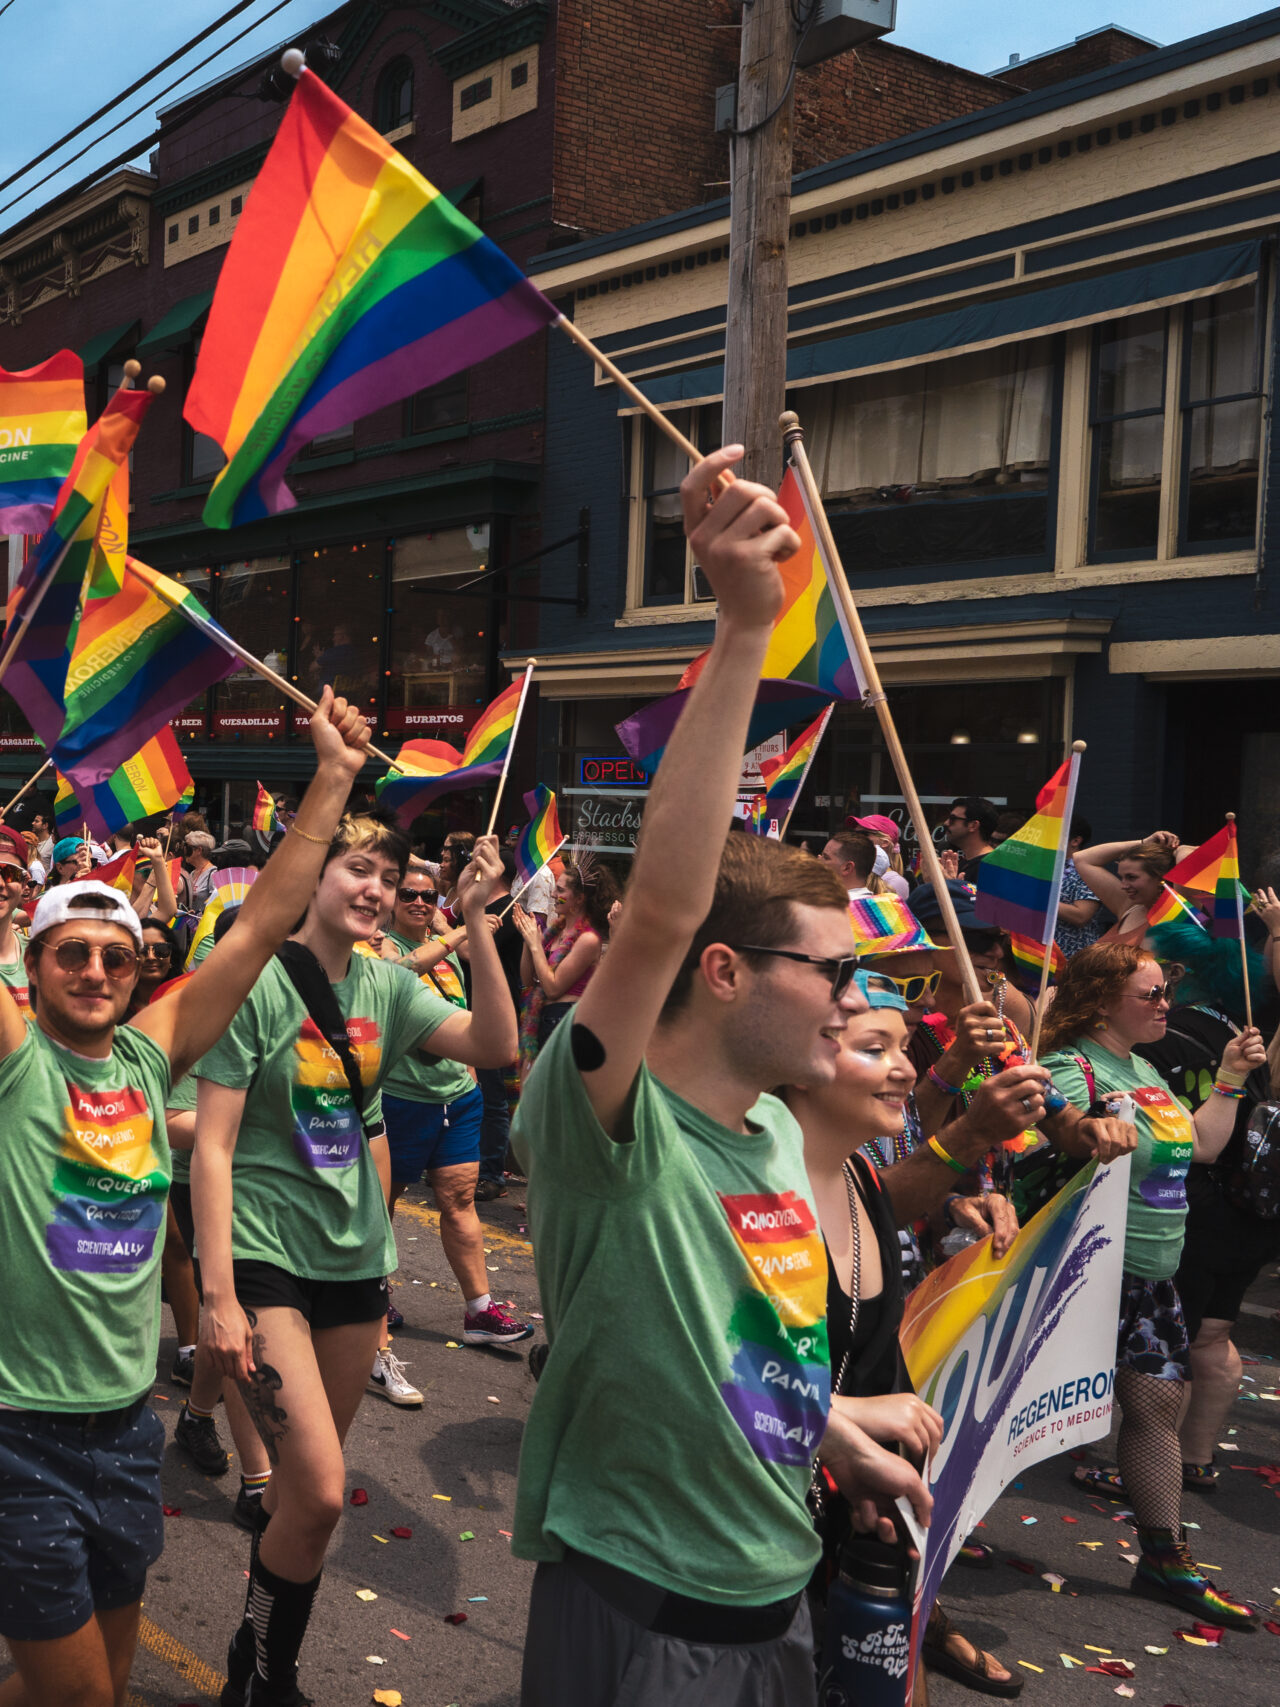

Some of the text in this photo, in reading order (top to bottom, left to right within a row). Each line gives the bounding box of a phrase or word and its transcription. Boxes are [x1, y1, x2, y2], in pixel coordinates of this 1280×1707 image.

[220, 718, 280, 726] QUESADILLAS
[405, 714, 464, 724] BURRITOS
[577, 799, 641, 828] Stacks
[1013, 1402, 1112, 1458] SCIENCE TO MEDICIN
[883, 1623, 907, 1647] The
[841, 1634, 882, 1666] State
